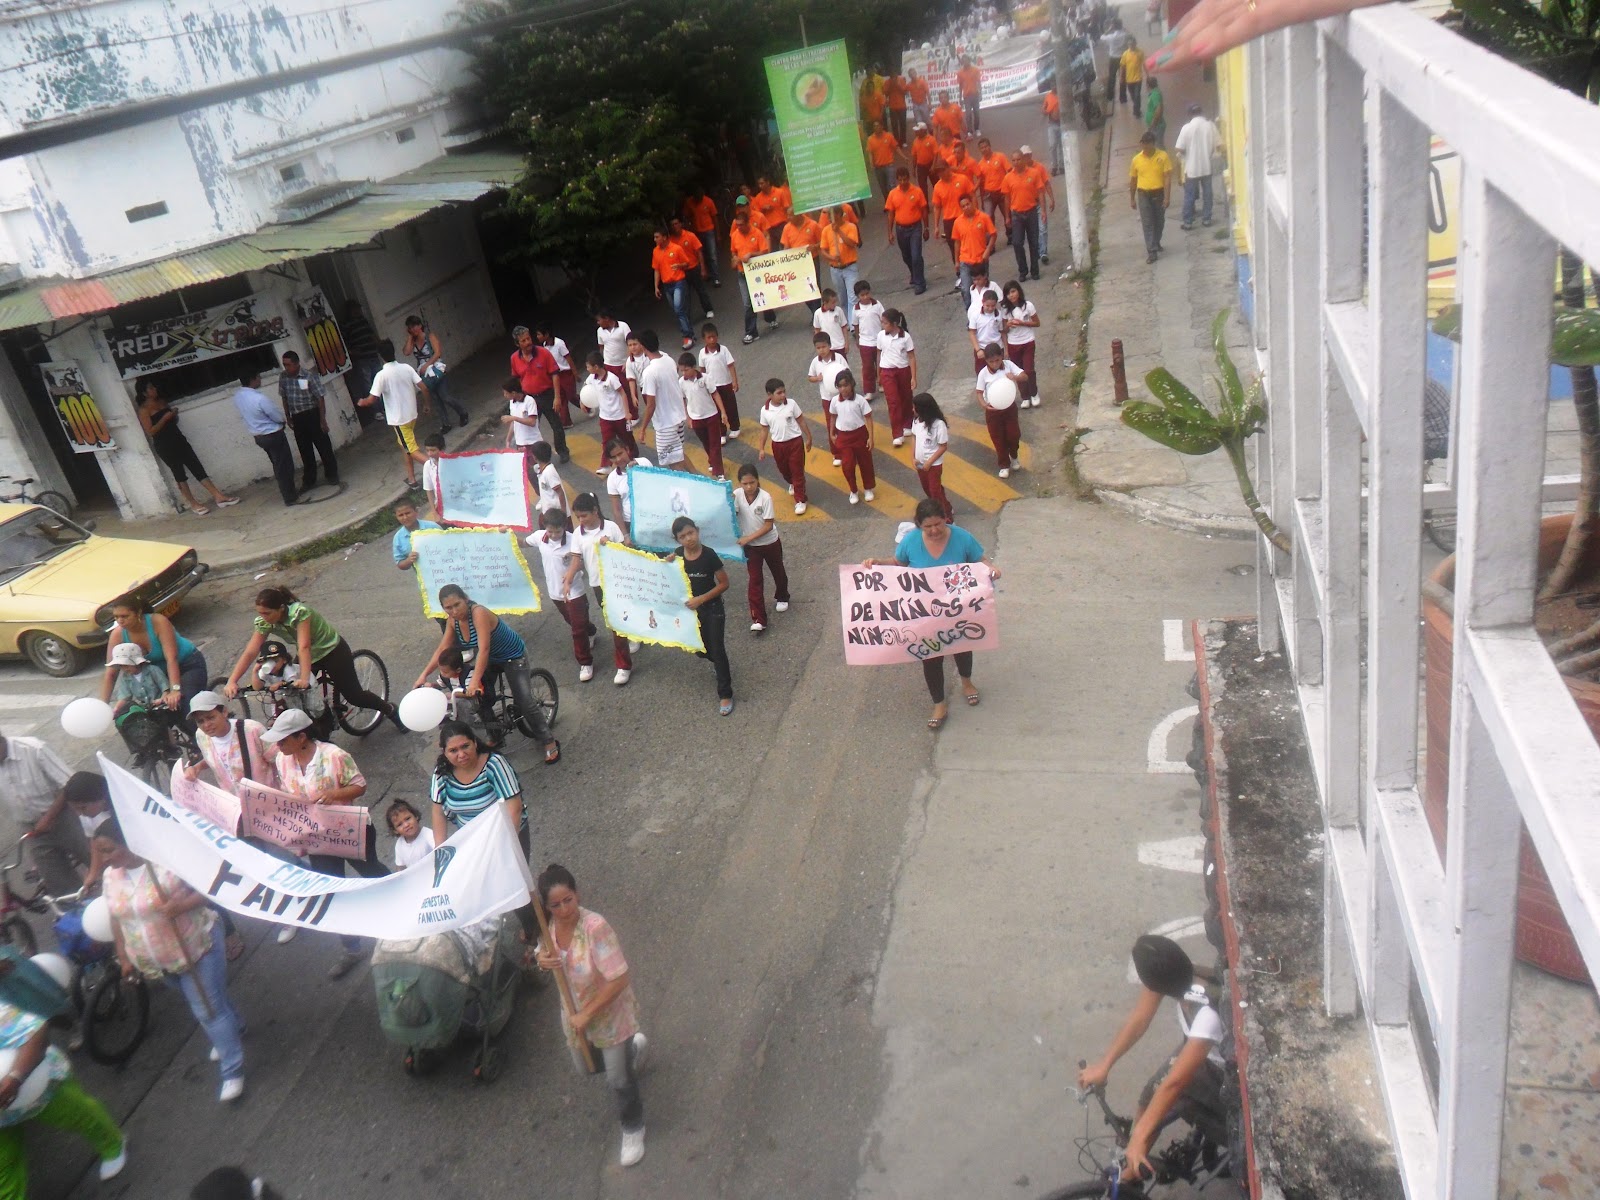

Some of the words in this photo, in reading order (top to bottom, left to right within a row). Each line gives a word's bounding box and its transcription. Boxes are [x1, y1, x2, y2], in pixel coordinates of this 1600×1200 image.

[117, 332, 170, 358] RED
[307, 319, 347, 377] 100
[141, 360, 169, 372] BANDA
[170, 354, 198, 364] ANCHA
[58, 394, 111, 446] 100
[475, 543, 502, 552] lactancia
[470, 555, 486, 564] mejor
[432, 568, 444, 578] para
[472, 574, 488, 584] mejor
[852, 571, 888, 592] POR
[896, 572, 935, 594] UN
[850, 602, 874, 622] DE
[247, 789, 267, 804] LA
[273, 795, 309, 814] LECHE
[252, 816, 275, 836] PARA
[276, 828, 287, 842] TU
[273, 816, 304, 838] MEJOR
[308, 832, 359, 847] ALIMENTO
[278, 806, 319, 832] MATERNA
[326, 828, 341, 837] ES
[418, 908, 457, 924] FAMILIAR
